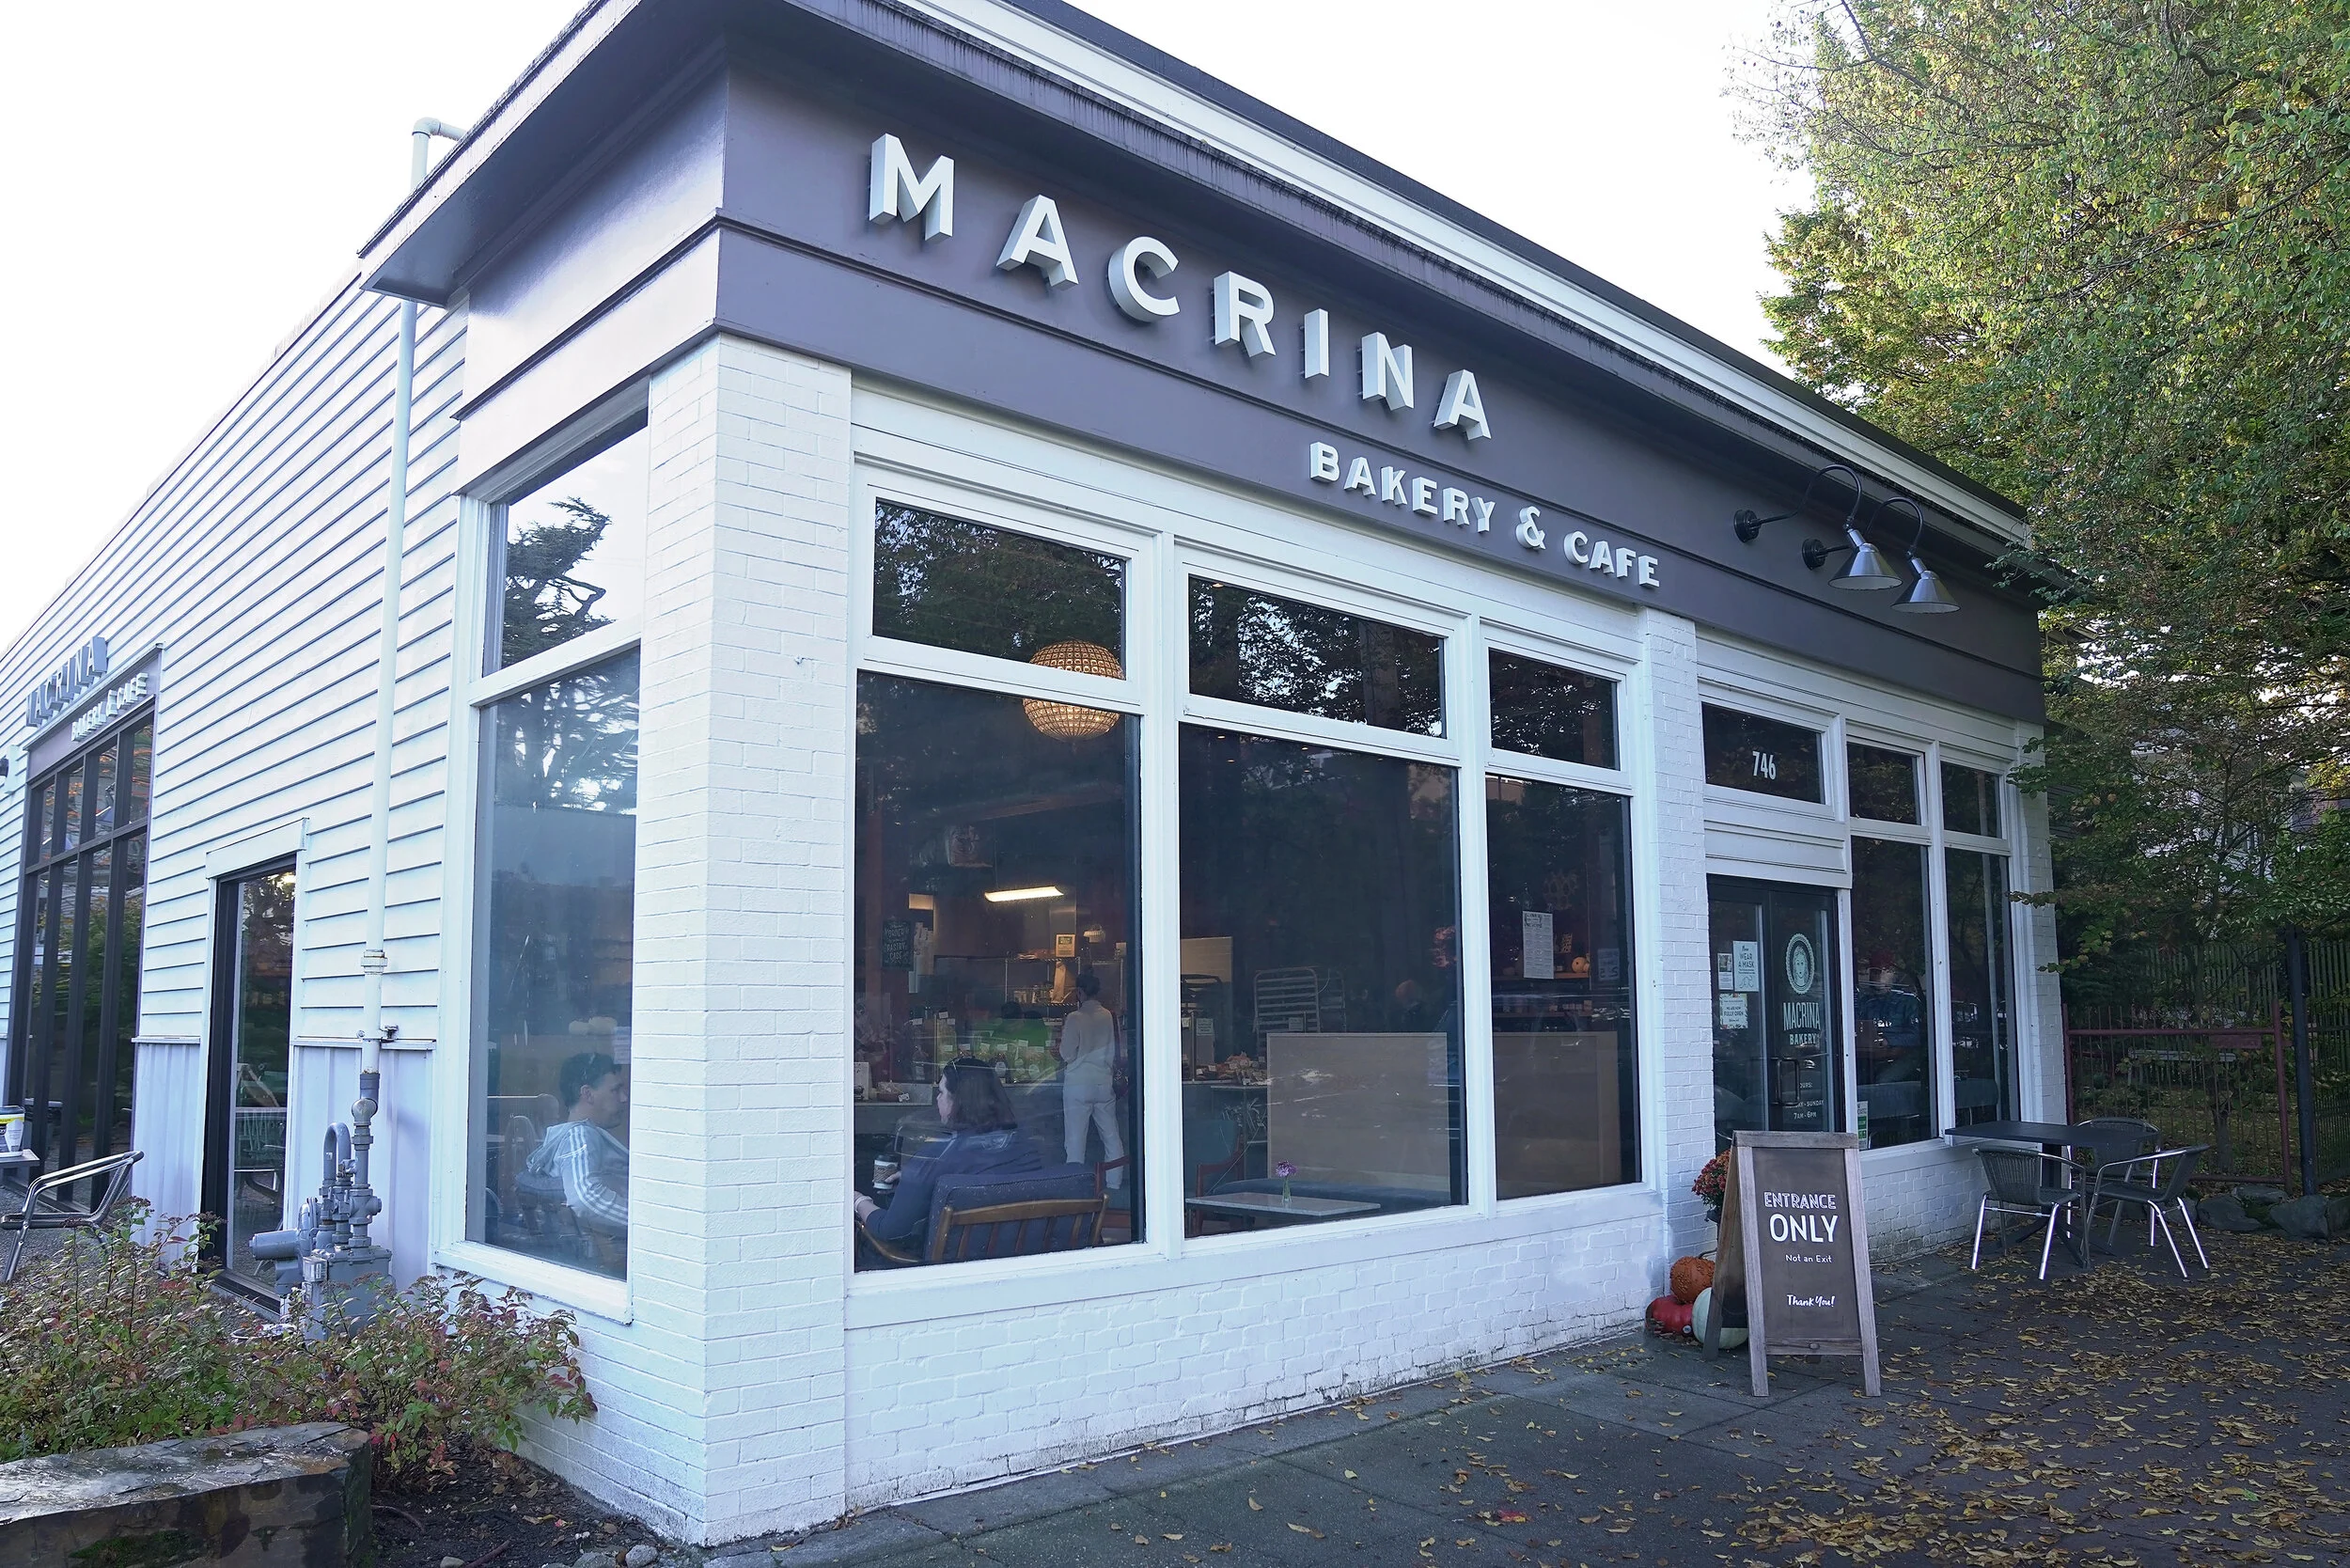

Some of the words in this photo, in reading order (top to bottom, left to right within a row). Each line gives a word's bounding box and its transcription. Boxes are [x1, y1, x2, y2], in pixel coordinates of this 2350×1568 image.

[870, 133, 1493, 440] MACRINA
[1310, 442, 1495, 532] BAKERY
[1515, 506, 1545, 550] &
[1563, 530, 1660, 588] CAFE
[1752, 750, 1777, 779] 746
[1783, 1002, 1821, 1031] MACRINA
[1789, 1033, 1816, 1045] BAKERY
[1763, 1192, 1837, 1210] ENTRANCE
[1769, 1214, 1838, 1243] ONLY
[1785, 1254, 1801, 1263] Not
[1815, 1254, 1833, 1263] Exit
[1786, 1294, 1814, 1307] Thank
[1814, 1295, 1836, 1308] You!
